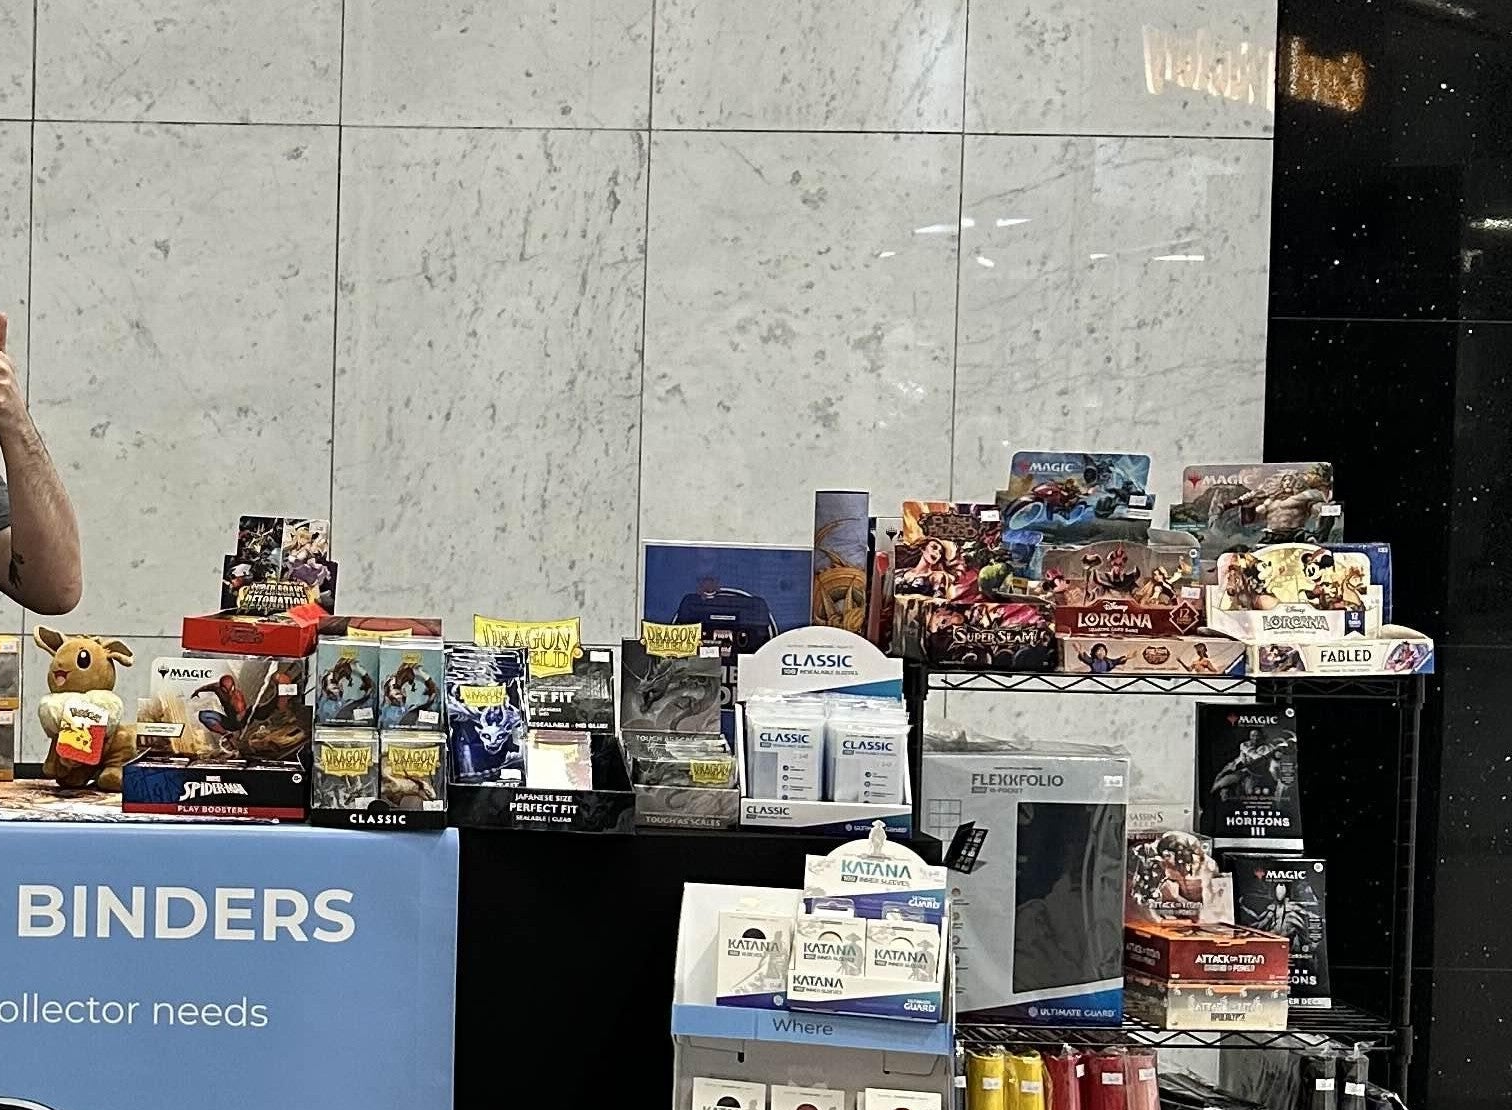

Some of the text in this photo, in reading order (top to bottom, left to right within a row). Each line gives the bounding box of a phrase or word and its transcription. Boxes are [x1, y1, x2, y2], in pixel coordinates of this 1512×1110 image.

[1030, 462, 1074, 472] MAGIC
[1203, 474, 1252, 485] MAGIC
[1078, 612, 1152, 629] LORCANA
[1262, 615, 1330, 631] LORCANA
[483, 624, 571, 651] DRAGON
[648, 626, 699, 642] DRAGON
[952, 626, 995, 645] SUPER
[782, 654, 853, 668] CLASSIC
[1320, 649, 1372, 663] FABLED
[170, 668, 213, 680] MAGIC
[551, 692, 575, 703] FIT
[1238, 716, 1279, 724] MAGIC
[760, 732, 810, 744] CLASSIC
[842, 740, 894, 752] CLASSIC
[179, 781, 248, 802] SPIDER-MAN
[177, 805, 249, 814] PLAY BOOSTERS
[509, 802, 578, 814] PERFECT FIT
[746, 806, 790, 816] CLASSIC
[349, 814, 407, 824] CLASSIC
[646, 816, 675, 824] TOUGH
[1226, 817, 1290, 827] HORIZONS
[841, 860, 912, 880] KATANA
[1266, 870, 1306, 881] MAGIC
[908, 899, 941, 909] GUARD
[16, 883, 356, 943] BINDERS
[728, 938, 780, 952] KATANA
[804, 942, 857, 956] KATANA
[874, 949, 928, 964] KATANA
[1195, 955, 1230, 964] ATTACK
[792, 974, 844, 989] KATANA
[151, 995, 269, 1028] needs
[904, 1002, 936, 1013] GUARD
[1040, 1008, 1116, 1018] ULTIMATE GUARD
[772, 1018, 834, 1036] Where
